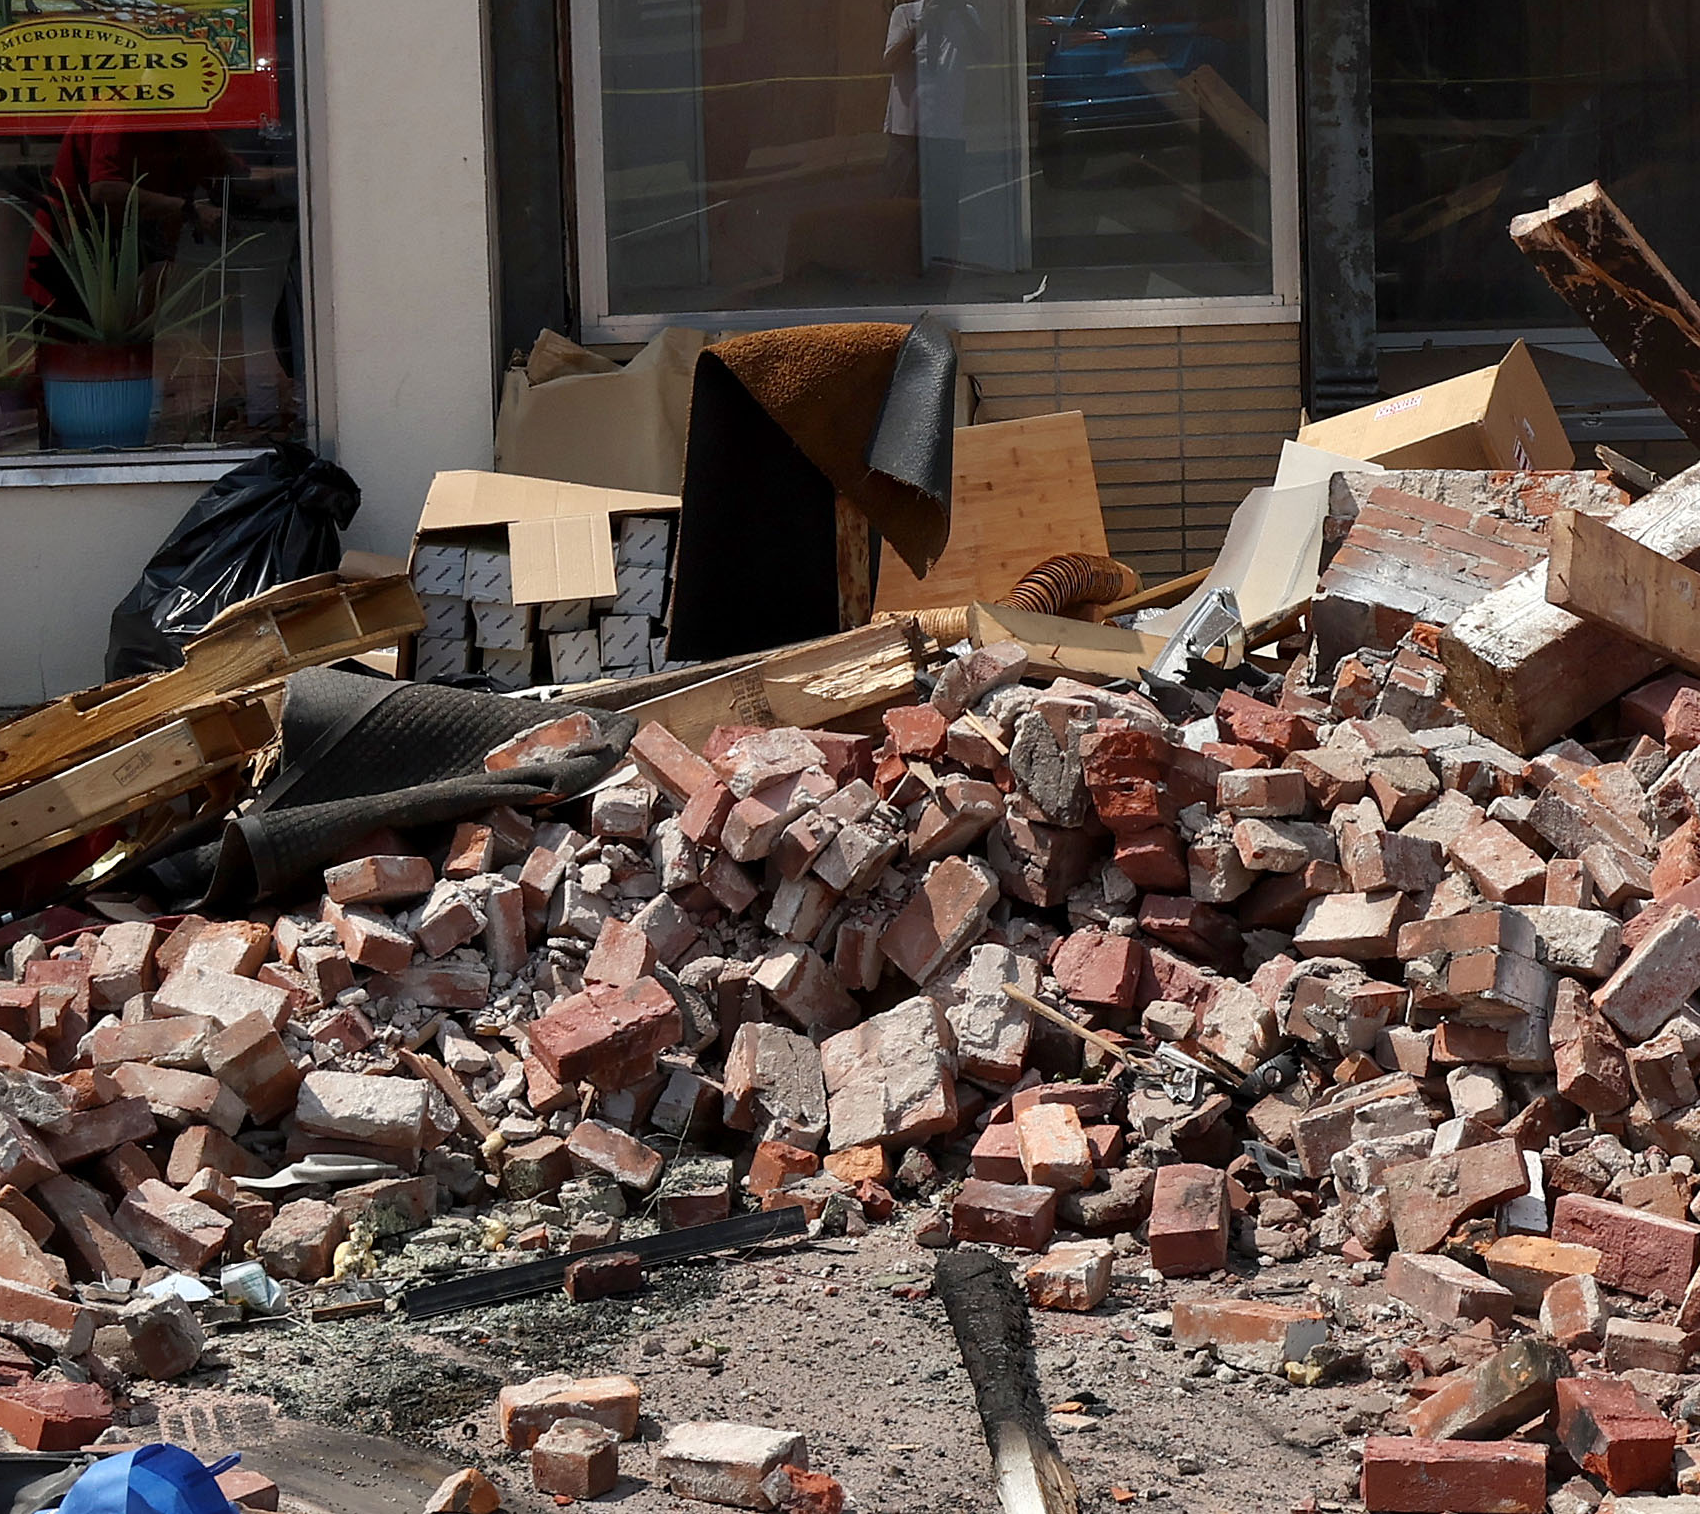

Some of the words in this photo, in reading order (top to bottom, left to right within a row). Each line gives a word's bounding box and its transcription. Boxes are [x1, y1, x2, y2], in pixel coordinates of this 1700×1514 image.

[0, 27, 138, 52] MICROBREWED
[49, 74, 86, 83] AND
[57, 83, 176, 102] MIXES
